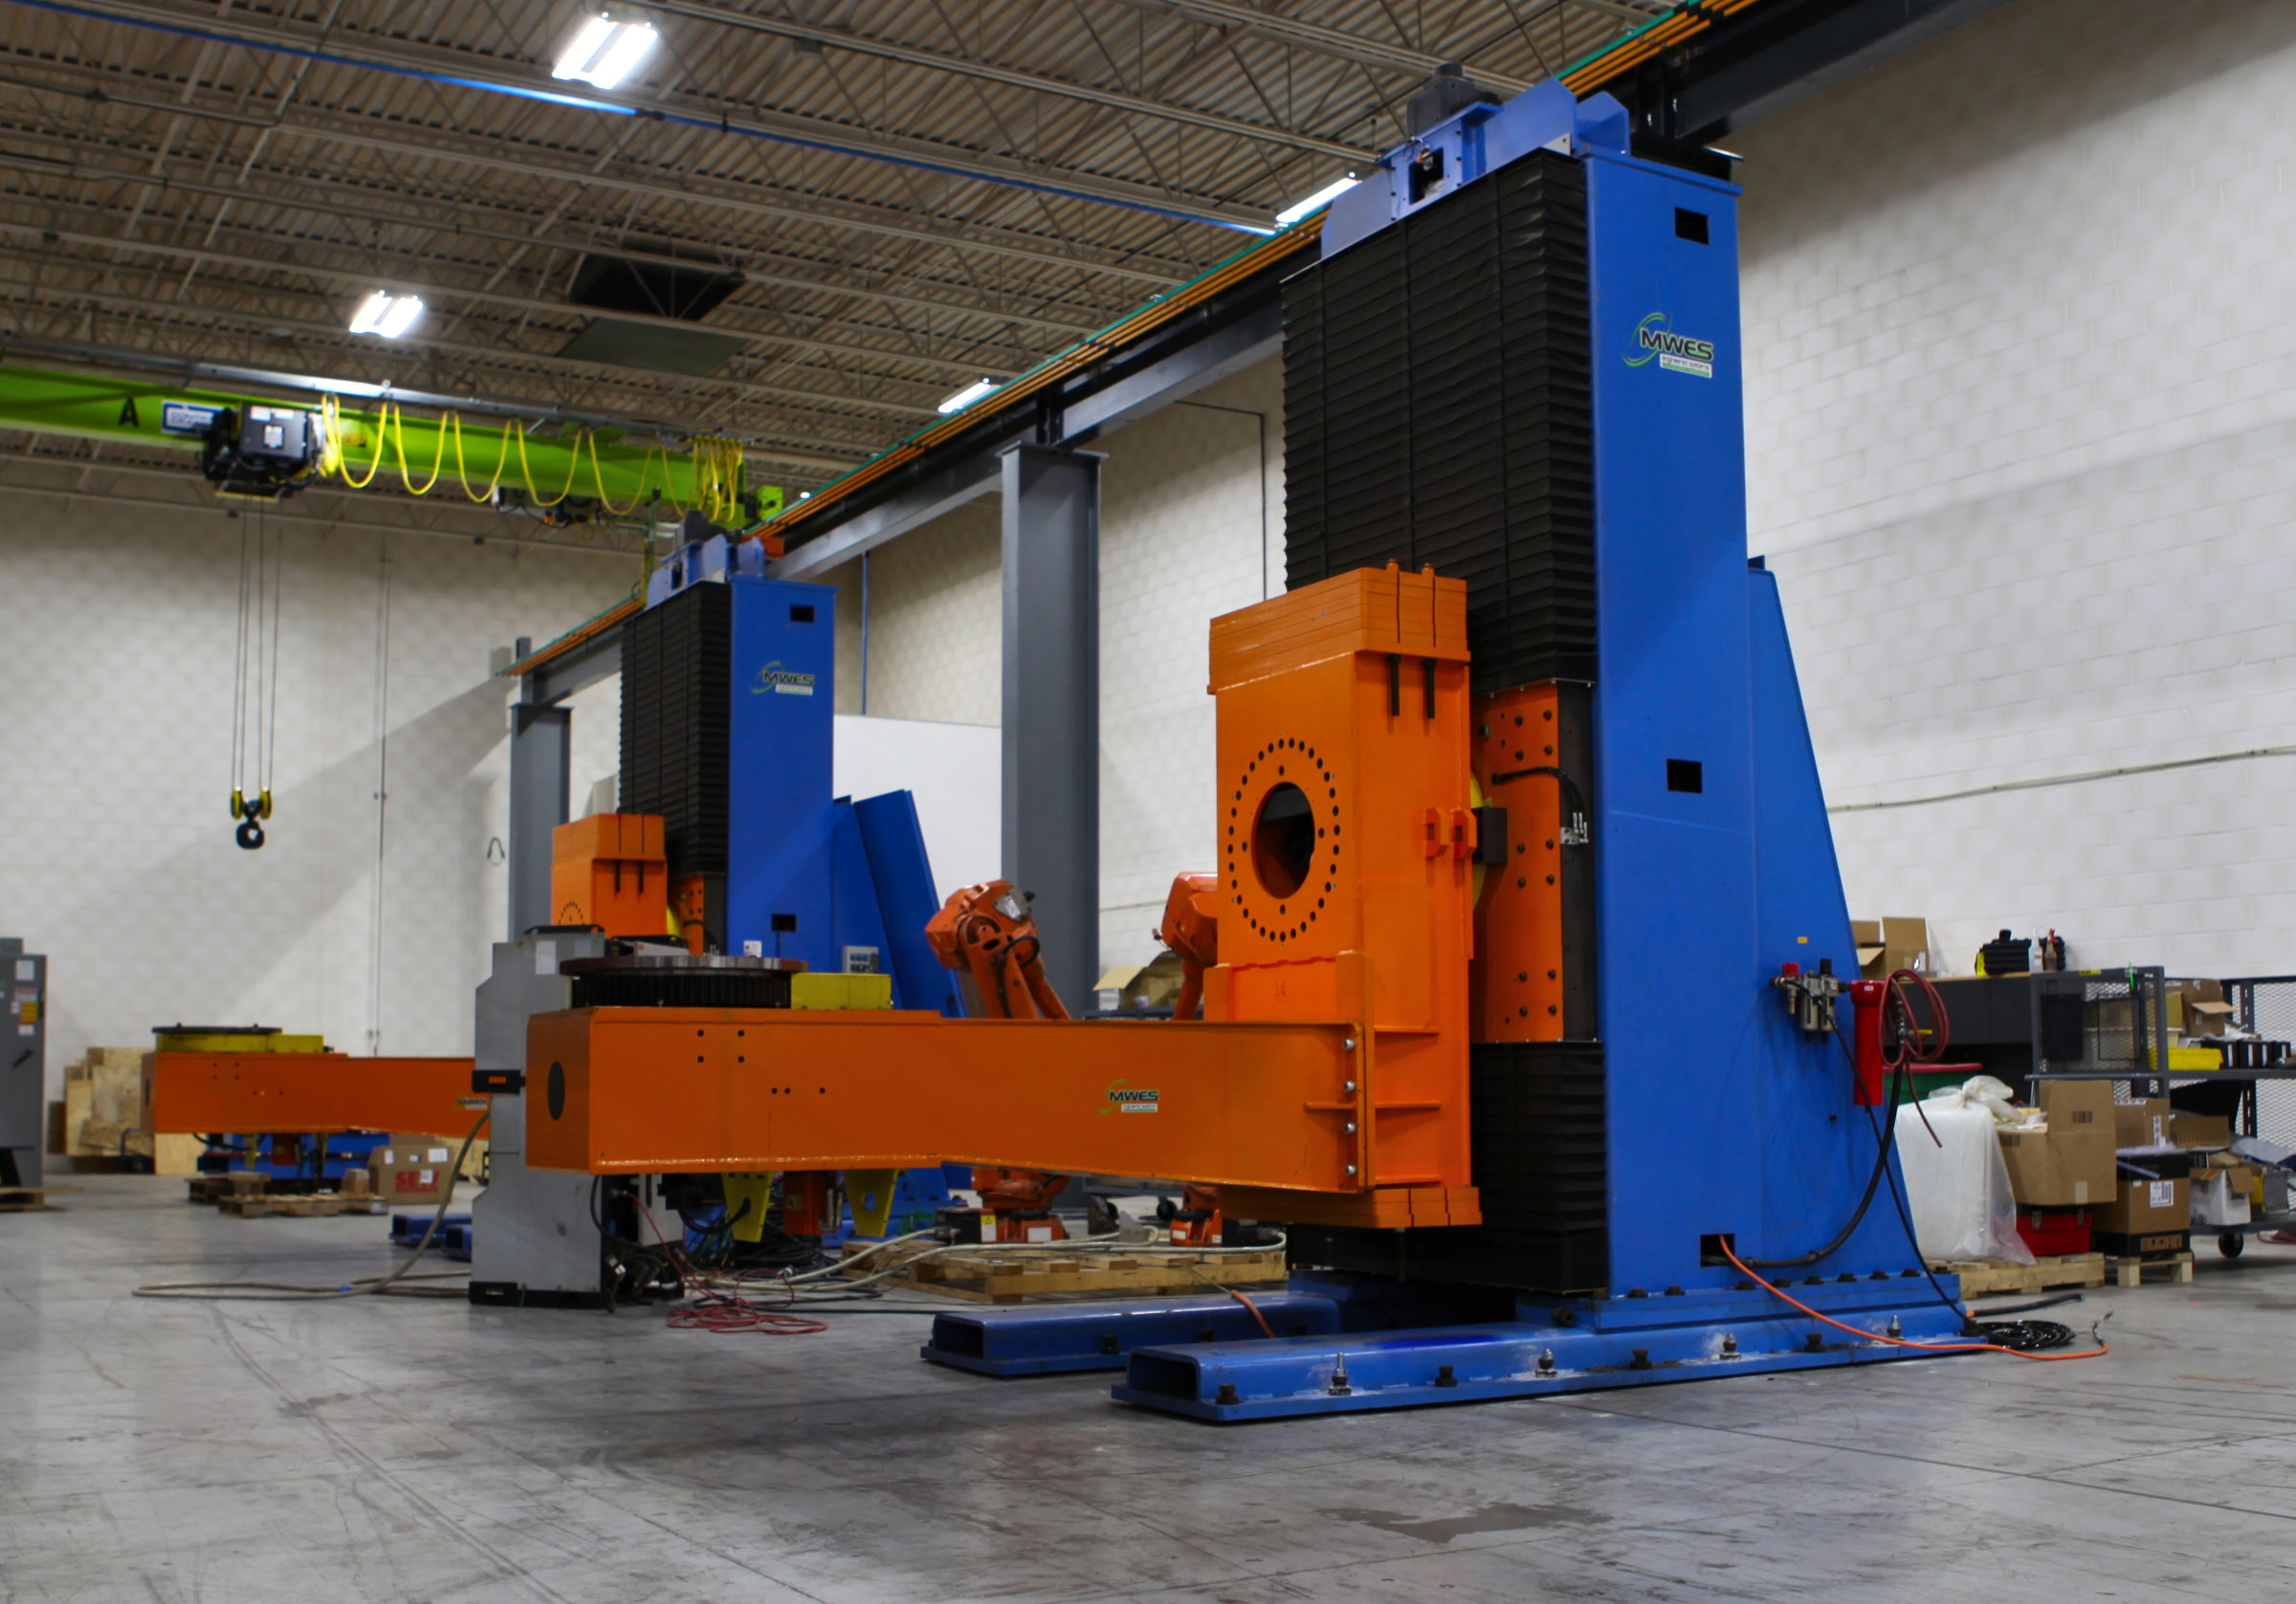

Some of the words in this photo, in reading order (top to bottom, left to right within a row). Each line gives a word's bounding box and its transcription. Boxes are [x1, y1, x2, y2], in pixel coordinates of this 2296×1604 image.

[1641, 327, 1713, 362] MWES
[119, 397, 140, 428] A
[763, 671, 814, 686] MWES
[1109, 1089, 1159, 1102] MWES
